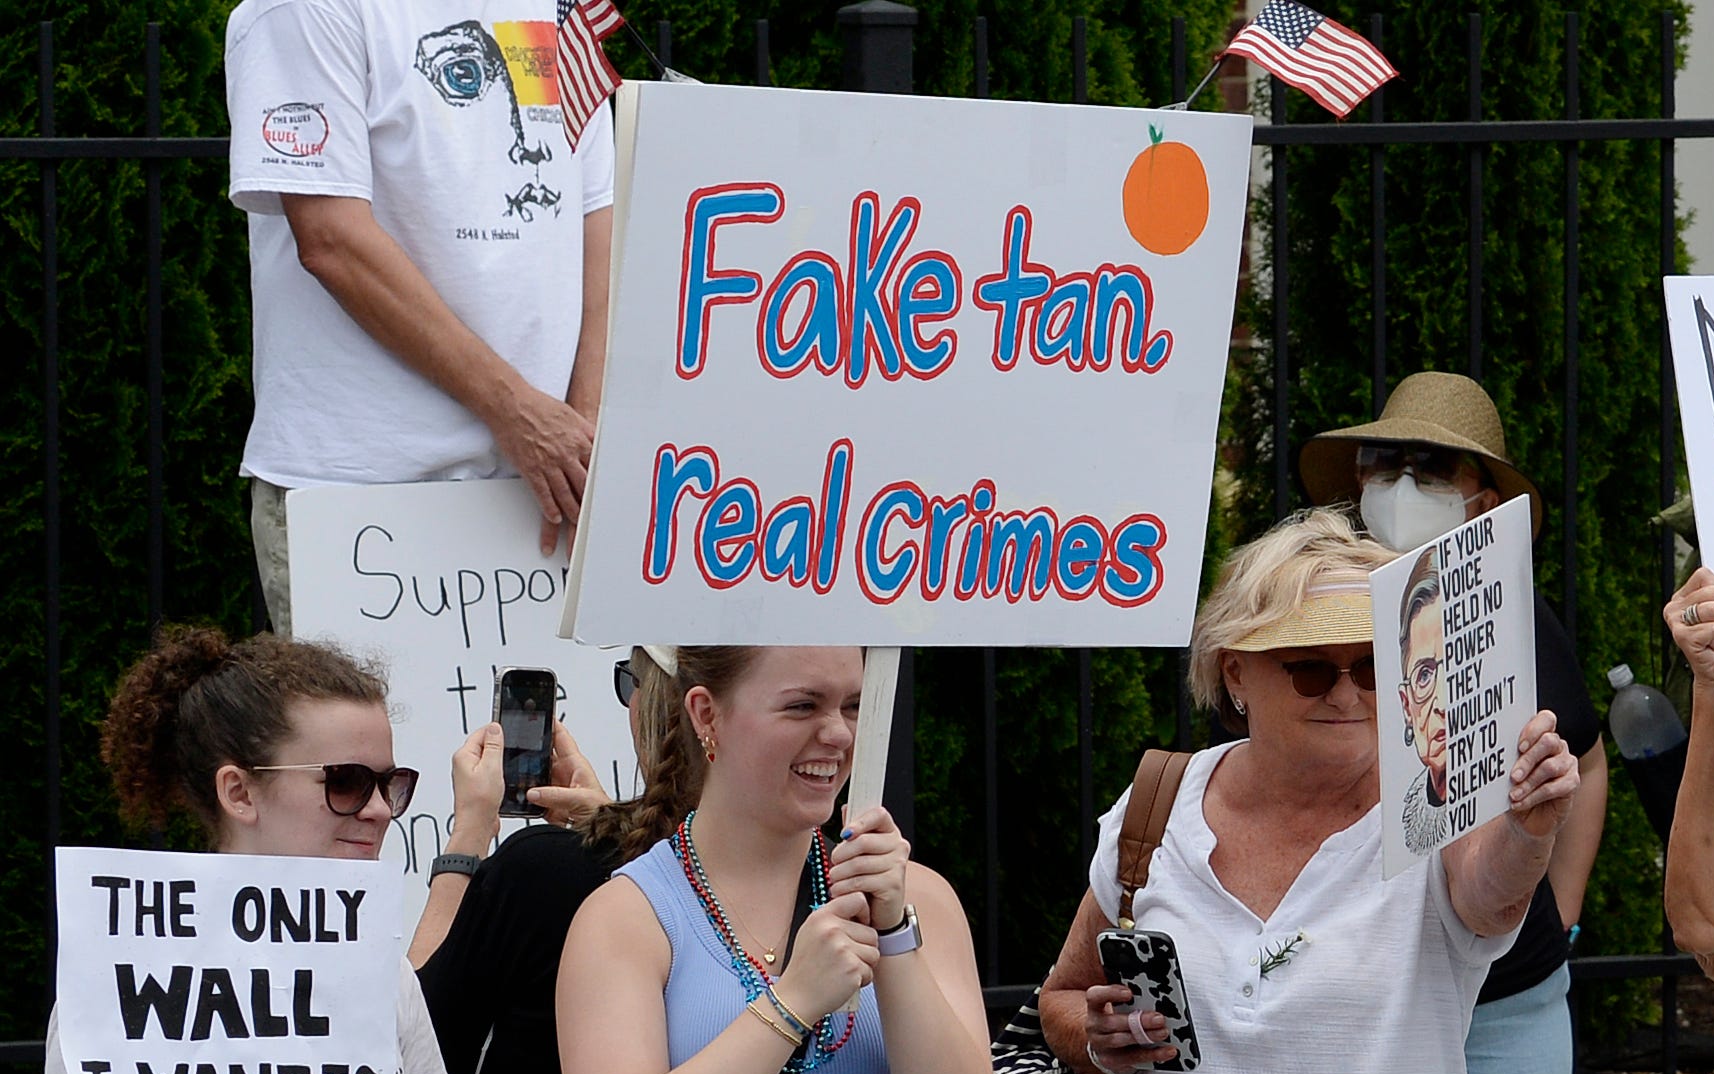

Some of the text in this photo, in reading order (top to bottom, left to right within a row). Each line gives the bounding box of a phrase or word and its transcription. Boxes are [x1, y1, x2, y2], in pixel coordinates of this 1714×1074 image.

[264, 131, 296, 143] BLUES
[676, 182, 962, 389] Fake
[643, 438, 854, 594] real
[1439, 516, 1494, 571] IF YOUR
[1442, 556, 1483, 603] VOICE
[1443, 580, 1503, 638] HELD NO
[1445, 619, 1495, 673] POWER
[1446, 658, 1483, 704] THEY
[1448, 675, 1516, 739] WOULDN'T
[1448, 719, 1497, 772] TRY TO
[1448, 747, 1505, 805] SILENCE
[1448, 796, 1477, 837] YOU
[91, 876, 367, 943] THE ONLY
[115, 964, 330, 1042] WALL
